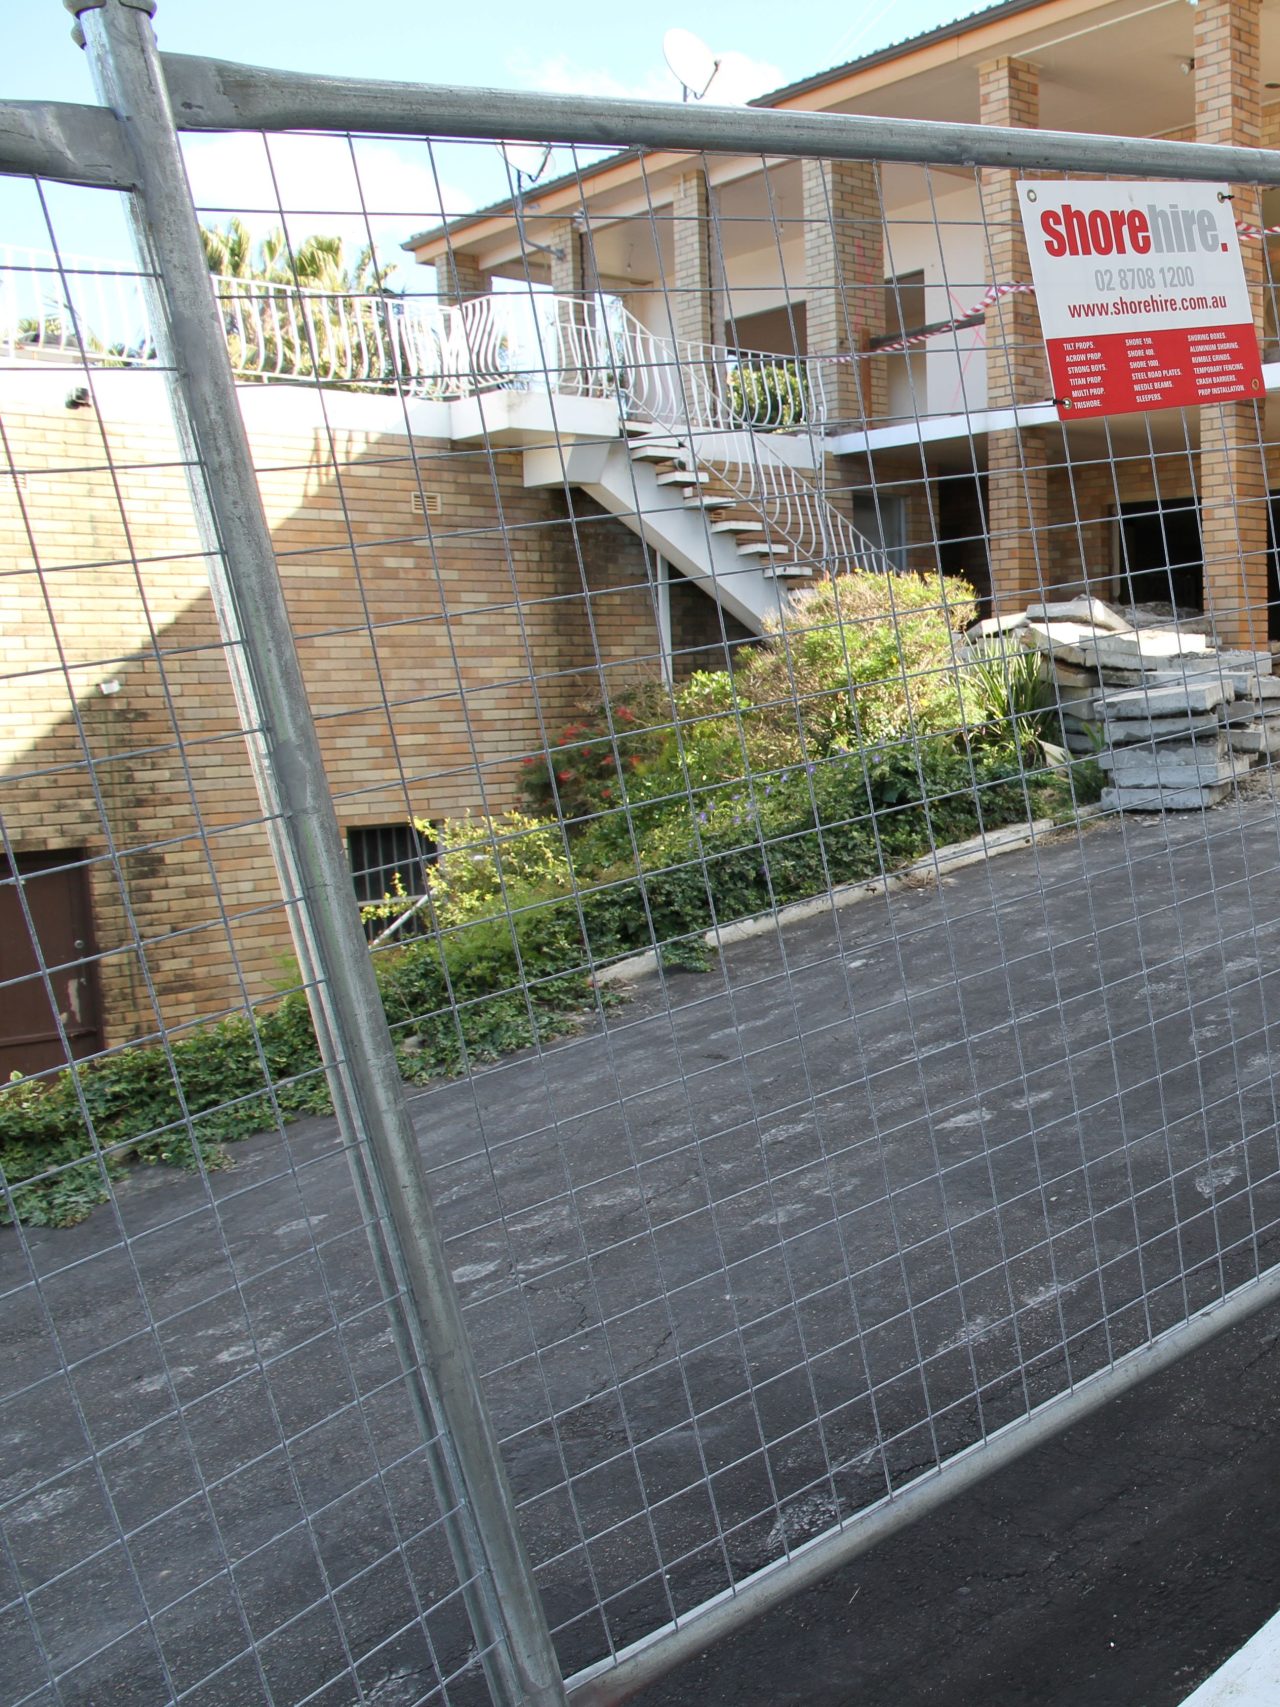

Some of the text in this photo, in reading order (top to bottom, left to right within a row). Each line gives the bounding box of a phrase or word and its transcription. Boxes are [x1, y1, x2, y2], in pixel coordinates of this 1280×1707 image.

[1094, 266, 1194, 292] 02 8708 1200
[1068, 295, 1227, 318] www.shorehire.com.au
[1063, 343, 1074, 351] TILT
[1066, 354, 1086, 362] ACROW
[1068, 366, 1090, 374] STRONG
[1194, 366, 1223, 374] TEMPORARY
[1132, 372, 1148, 380] STEEL
[1069, 377, 1086, 386] TITAN
[1196, 377, 1212, 385] CRASH
